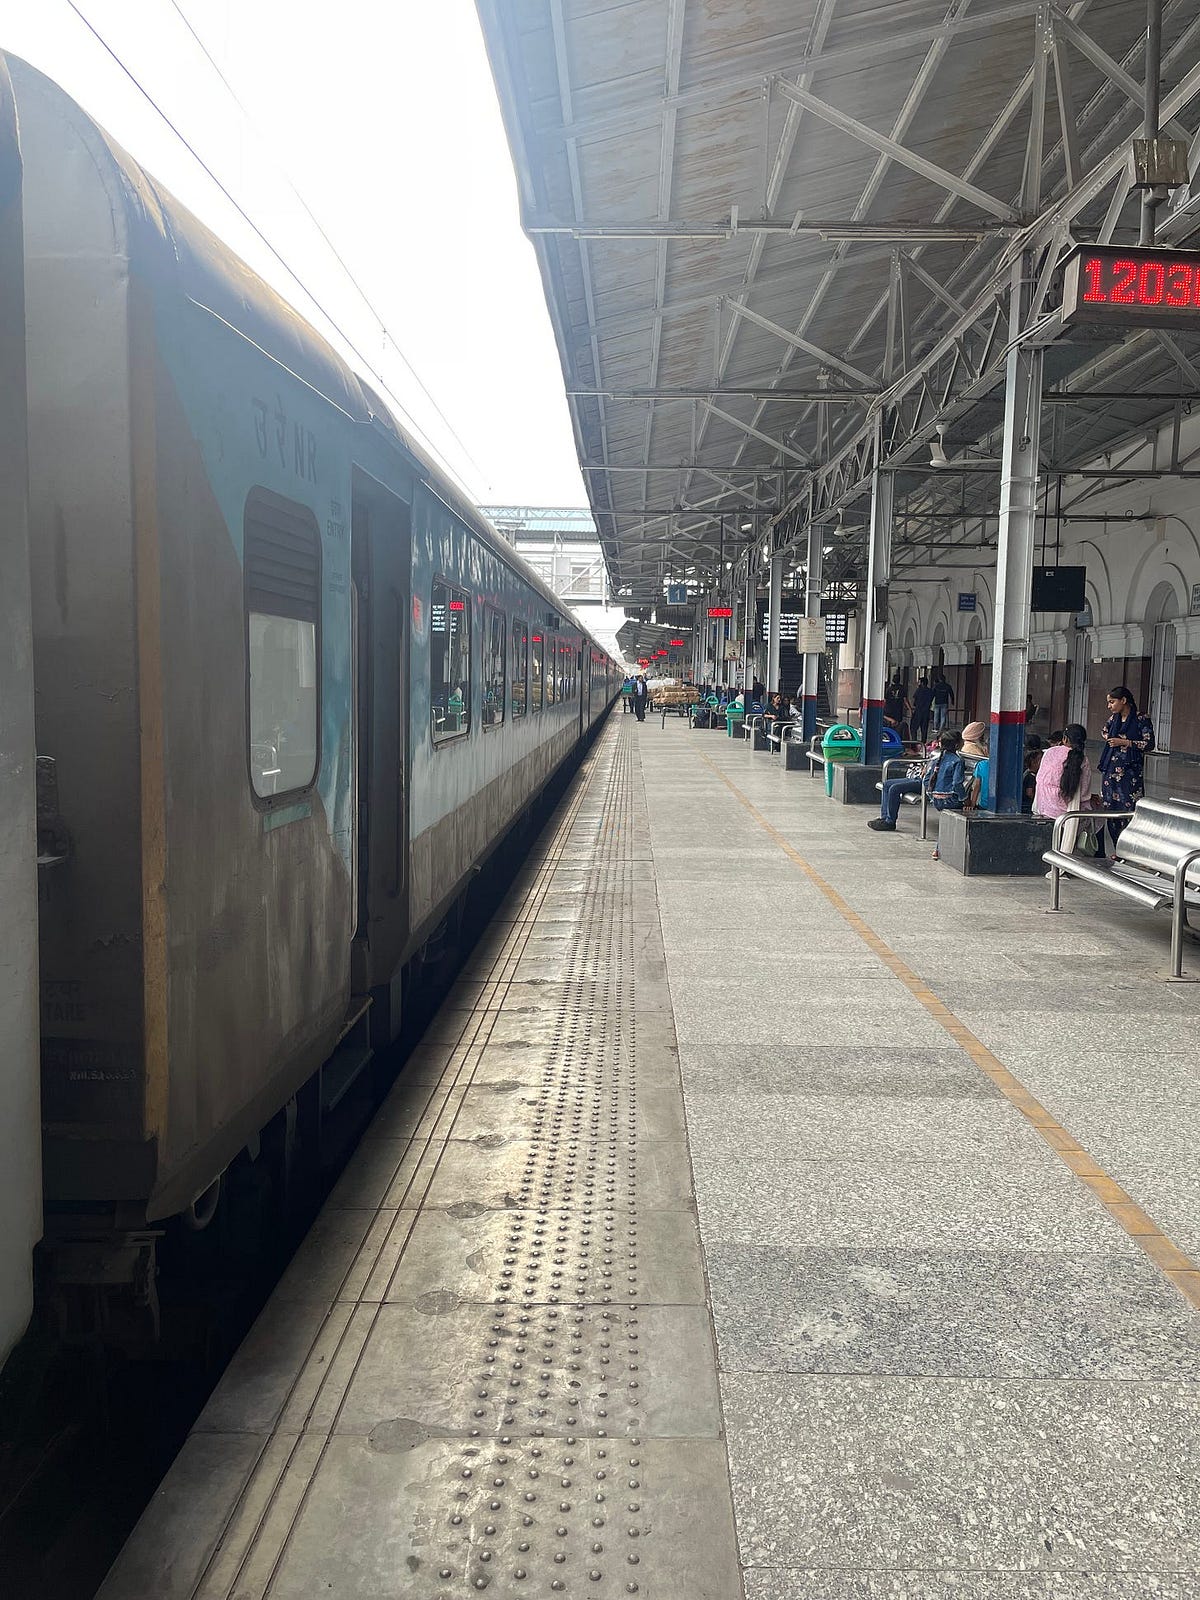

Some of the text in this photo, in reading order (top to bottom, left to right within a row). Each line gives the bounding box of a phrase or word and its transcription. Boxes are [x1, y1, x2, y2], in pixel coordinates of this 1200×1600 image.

[1083, 258, 1200, 308] 1203
[294, 421, 318, 486] NR
[326, 519, 345, 540] ENTRY
[675, 588, 681, 601] 1
